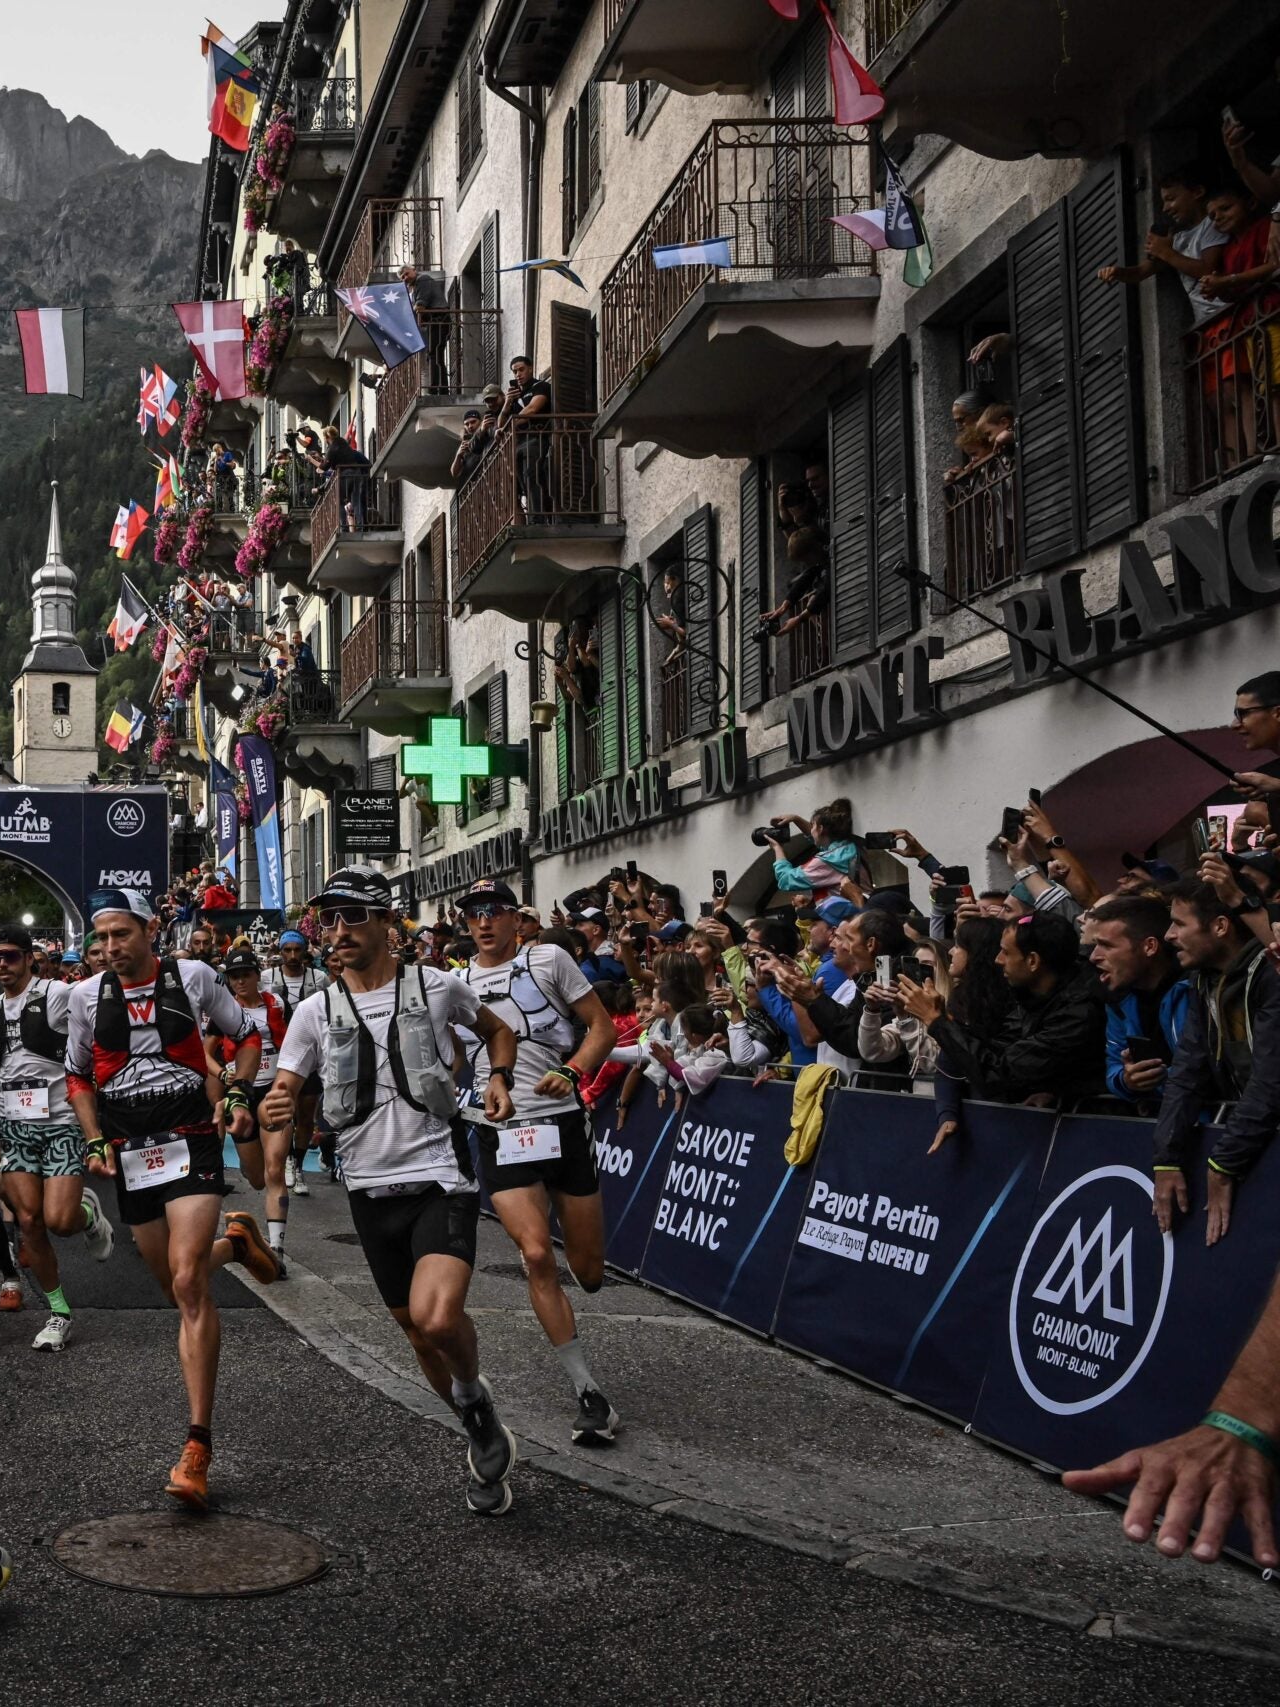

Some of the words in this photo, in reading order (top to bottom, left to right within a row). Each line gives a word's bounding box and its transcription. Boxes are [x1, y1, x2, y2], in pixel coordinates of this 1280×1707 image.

[538, 760, 666, 855] PHARMACIE
[699, 726, 748, 801] DU
[786, 636, 944, 766] MONT
[351, 797, 393, 805] PLANET
[0, 815, 51, 832] UTMB
[26, 834, 49, 842] BLANC
[98, 869, 153, 886] HOKA
[365, 1010, 392, 1021] TERREX
[19, 1097, 32, 1107] 12
[513, 1127, 536, 1138] UTMB
[518, 1135, 535, 1148] 11
[676, 1120, 756, 1168] SAVOIE
[139, 1147, 164, 1159] UTMB
[595, 1127, 634, 1178] hoo
[145, 1155, 165, 1171] 25
[664, 1160, 729, 1206] MONT
[808, 1179, 870, 1223] Payot
[871, 1194, 940, 1242] Pertin
[653, 1197, 729, 1252] BLANC
[803, 1221, 815, 1238] Le
[815, 1225, 839, 1249] Refuge
[840, 1231, 865, 1255] Payot
[867, 1239, 915, 1273] SUPER
[913, 1251, 931, 1276] U
[1032, 1311, 1121, 1361] CHAMONIX
[1036, 1345, 1101, 1380] MONT-BLANC
